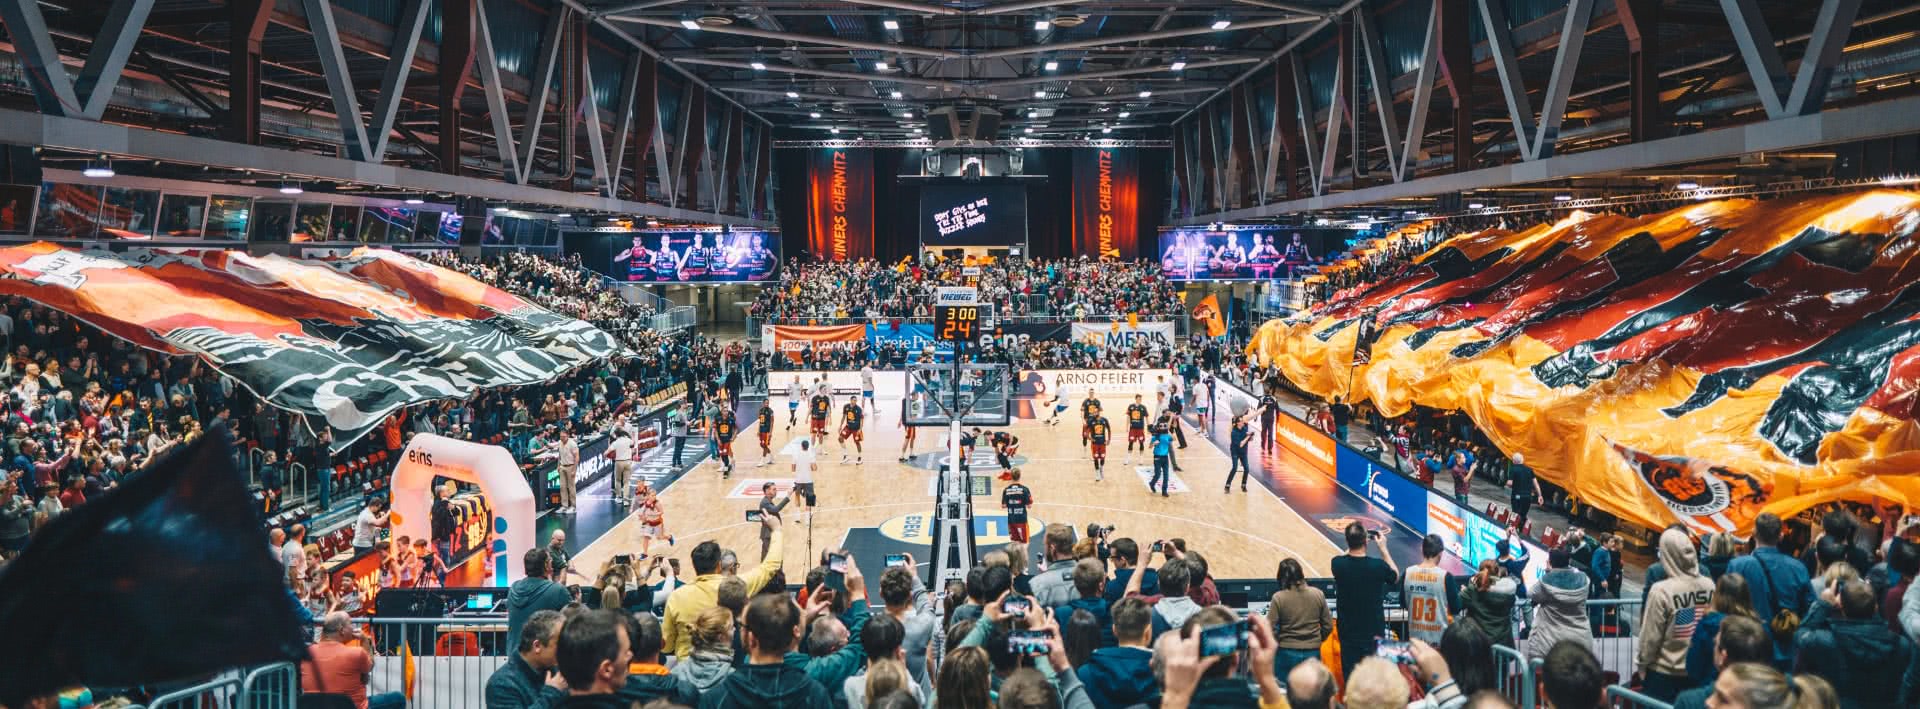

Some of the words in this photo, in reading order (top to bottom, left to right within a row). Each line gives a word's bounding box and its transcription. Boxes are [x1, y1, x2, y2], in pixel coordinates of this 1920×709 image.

[834, 150, 847, 213] CHEMNITZ
[1099, 150, 1113, 211] CHEMNITZ
[941, 293, 974, 301] VIEWEG
[943, 320, 971, 339] 24
[1055, 373, 1097, 385] ARNO
[1101, 372, 1145, 385] FEIERT
[408, 446, 433, 467] eins
[1409, 584, 1427, 592] eins
[1411, 596, 1438, 623] 03
